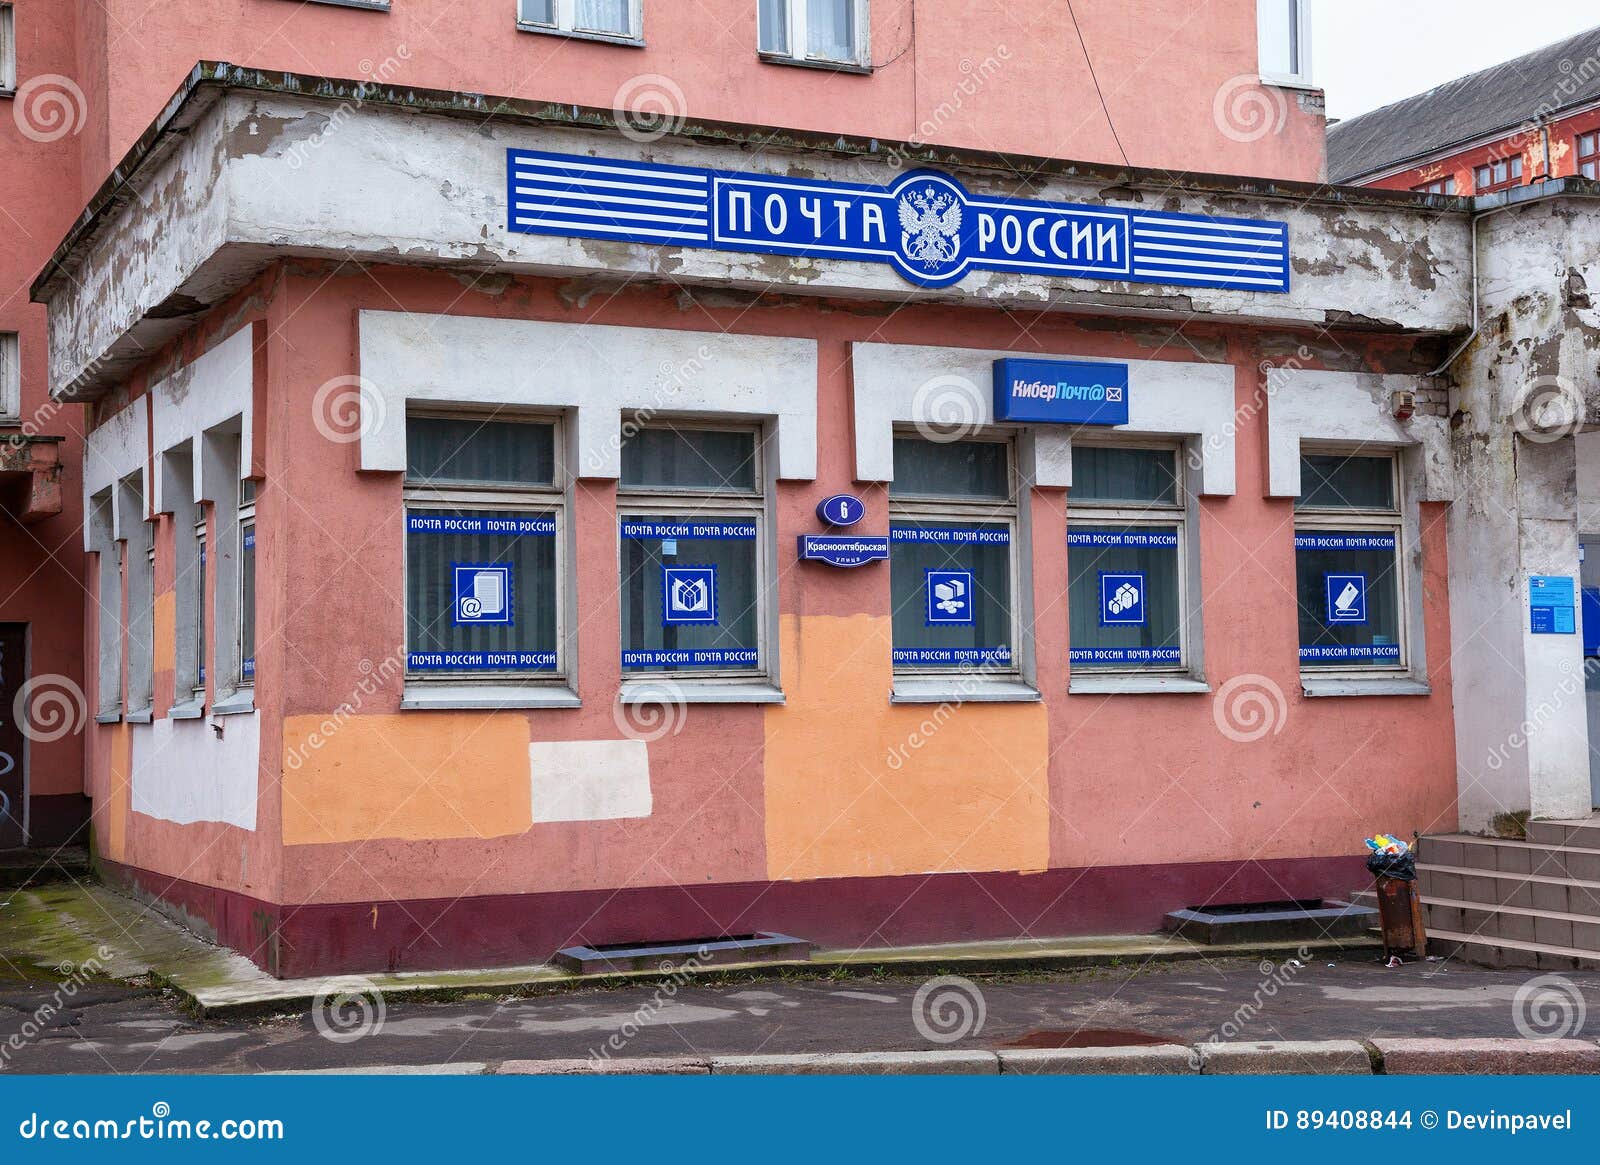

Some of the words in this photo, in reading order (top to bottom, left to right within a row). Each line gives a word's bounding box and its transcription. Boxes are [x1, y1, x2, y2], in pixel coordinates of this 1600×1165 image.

[728, 190, 886, 243] ПОЧТА
[978, 213, 1118, 262] РОССИИ
[1012, 380, 1105, 402] КиберПочт@
[840, 501, 849, 519] 6
[411, 519, 442, 530] ПОЧТА
[445, 519, 481, 530] РОССИИ
[487, 520, 516, 531] ПОЧТА
[519, 521, 555, 532] РОССИИ
[625, 525, 653, 535] ПОЧТА
[656, 525, 689, 536] РОССИИ
[693, 526, 720, 536] ПОЧТА
[723, 526, 756, 536] РОССИИ
[892, 530, 918, 540] ПОЧТА
[920, 530, 950, 540] РОССИИ
[953, 531, 978, 541] ПОЧТА
[980, 532, 1009, 542] РОССИИ
[1067, 534, 1091, 544] ПОЧТА
[1093, 534, 1121, 544] РОССИИ
[1124, 535, 1148, 544] ПОЧТА
[1149, 535, 1177, 545] РОССИИ
[807, 542, 887, 552] Краснооктябрьская
[1295, 537, 1316, 546] ПОЧТА
[1317, 538, 1344, 547] РОССИИ
[1346, 538, 1368, 547] ПОЧТА
[1368, 538, 1394, 547] РОССИИ
[625, 653, 653, 663] ПОЧТА
[656, 652, 689, 663] РОССИИ
[694, 652, 722, 662] ПОЧТА
[724, 651, 758, 662] РОССИИ
[893, 650, 919, 660] ПОЧТА
[920, 650, 950, 660] РОССИИ
[954, 650, 979, 660] ПОЧТА
[980, 650, 1011, 660] РОССИИ
[1069, 650, 1093, 659] ПОЧТА
[1095, 650, 1124, 659] РОССИИ
[1127, 650, 1150, 659] ПОЧТА
[1152, 649, 1180, 659] РОССИИ
[1298, 647, 1320, 656] ПОЧТА
[1321, 647, 1348, 656] РОССИИ
[1350, 647, 1372, 656] ПОЧТА
[1372, 647, 1399, 656] РОССИИ
[411, 654, 442, 665] ПОЧТА
[445, 654, 482, 665] РОССИИ
[488, 654, 517, 664] ПОЧТА
[520, 653, 556, 664] РОССИИ
